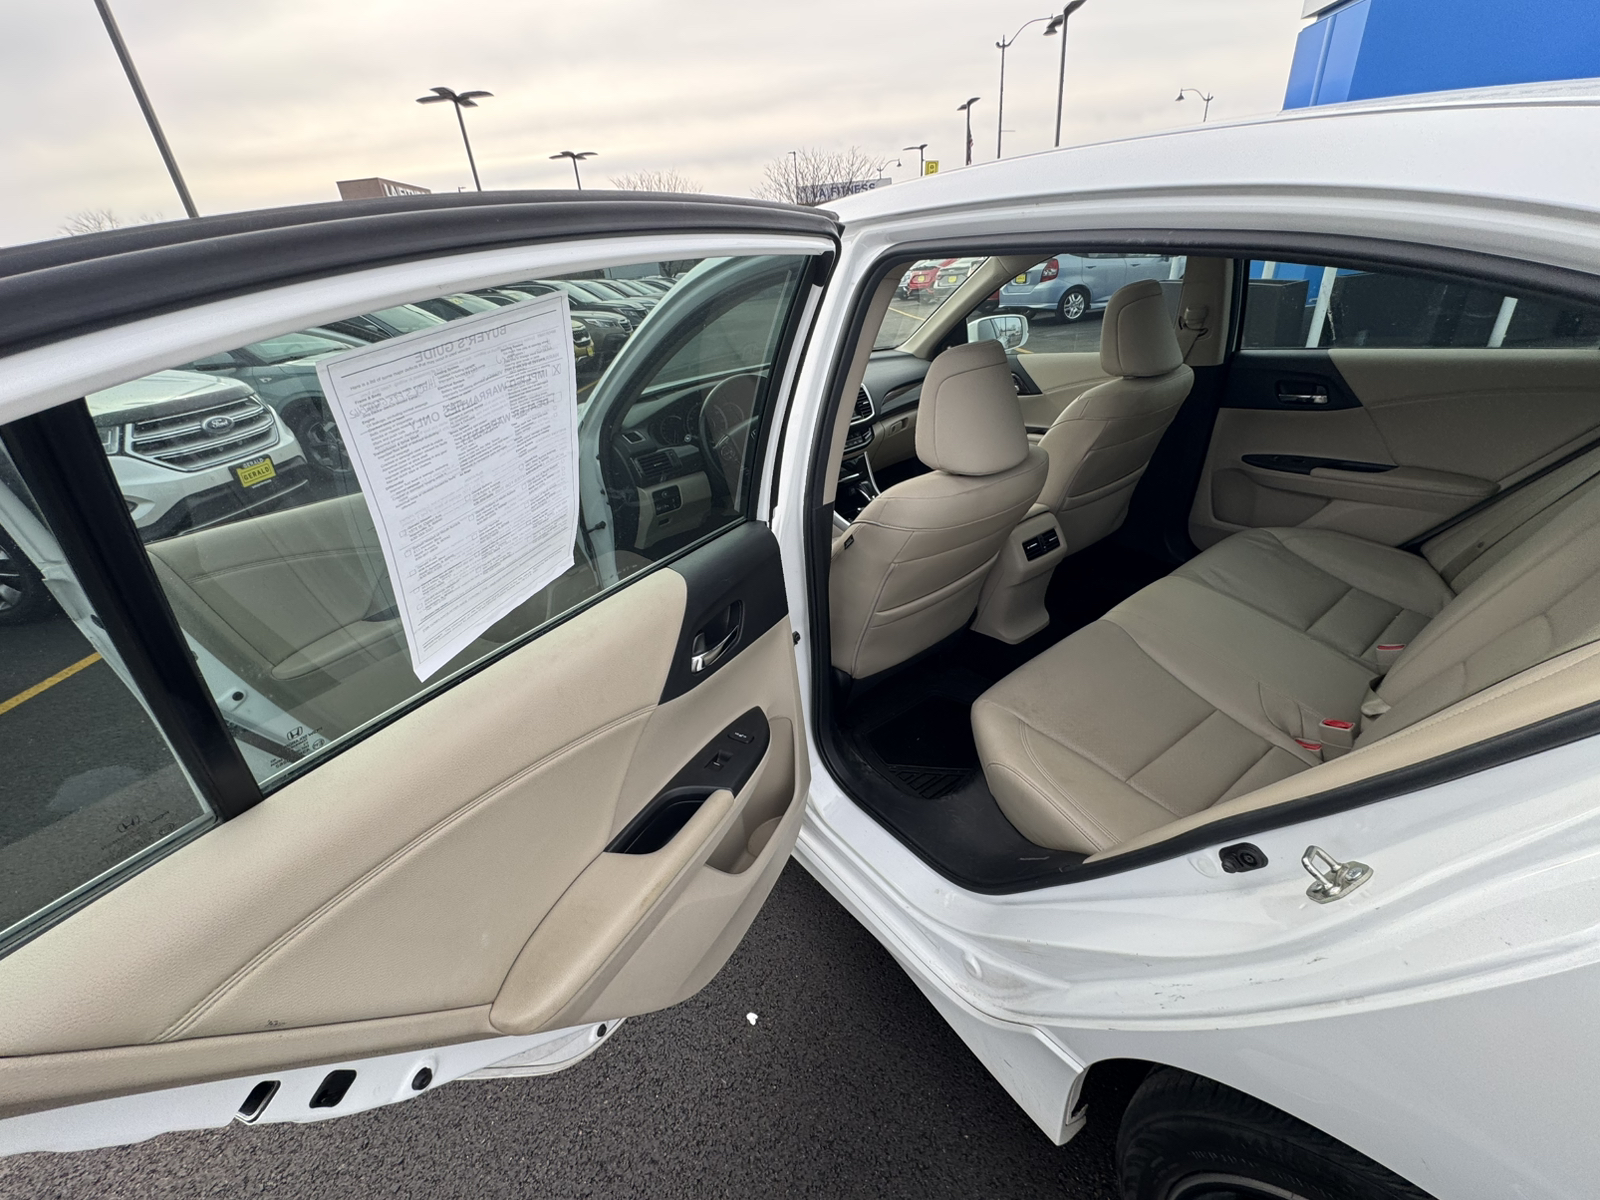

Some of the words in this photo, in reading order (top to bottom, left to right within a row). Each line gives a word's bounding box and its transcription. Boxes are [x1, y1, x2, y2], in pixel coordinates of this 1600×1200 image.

[830, 182, 876, 199] FITNESS
[211, 418, 229, 429] Ford
[242, 457, 265, 468] GERALD
[243, 467, 270, 480] GERALD
